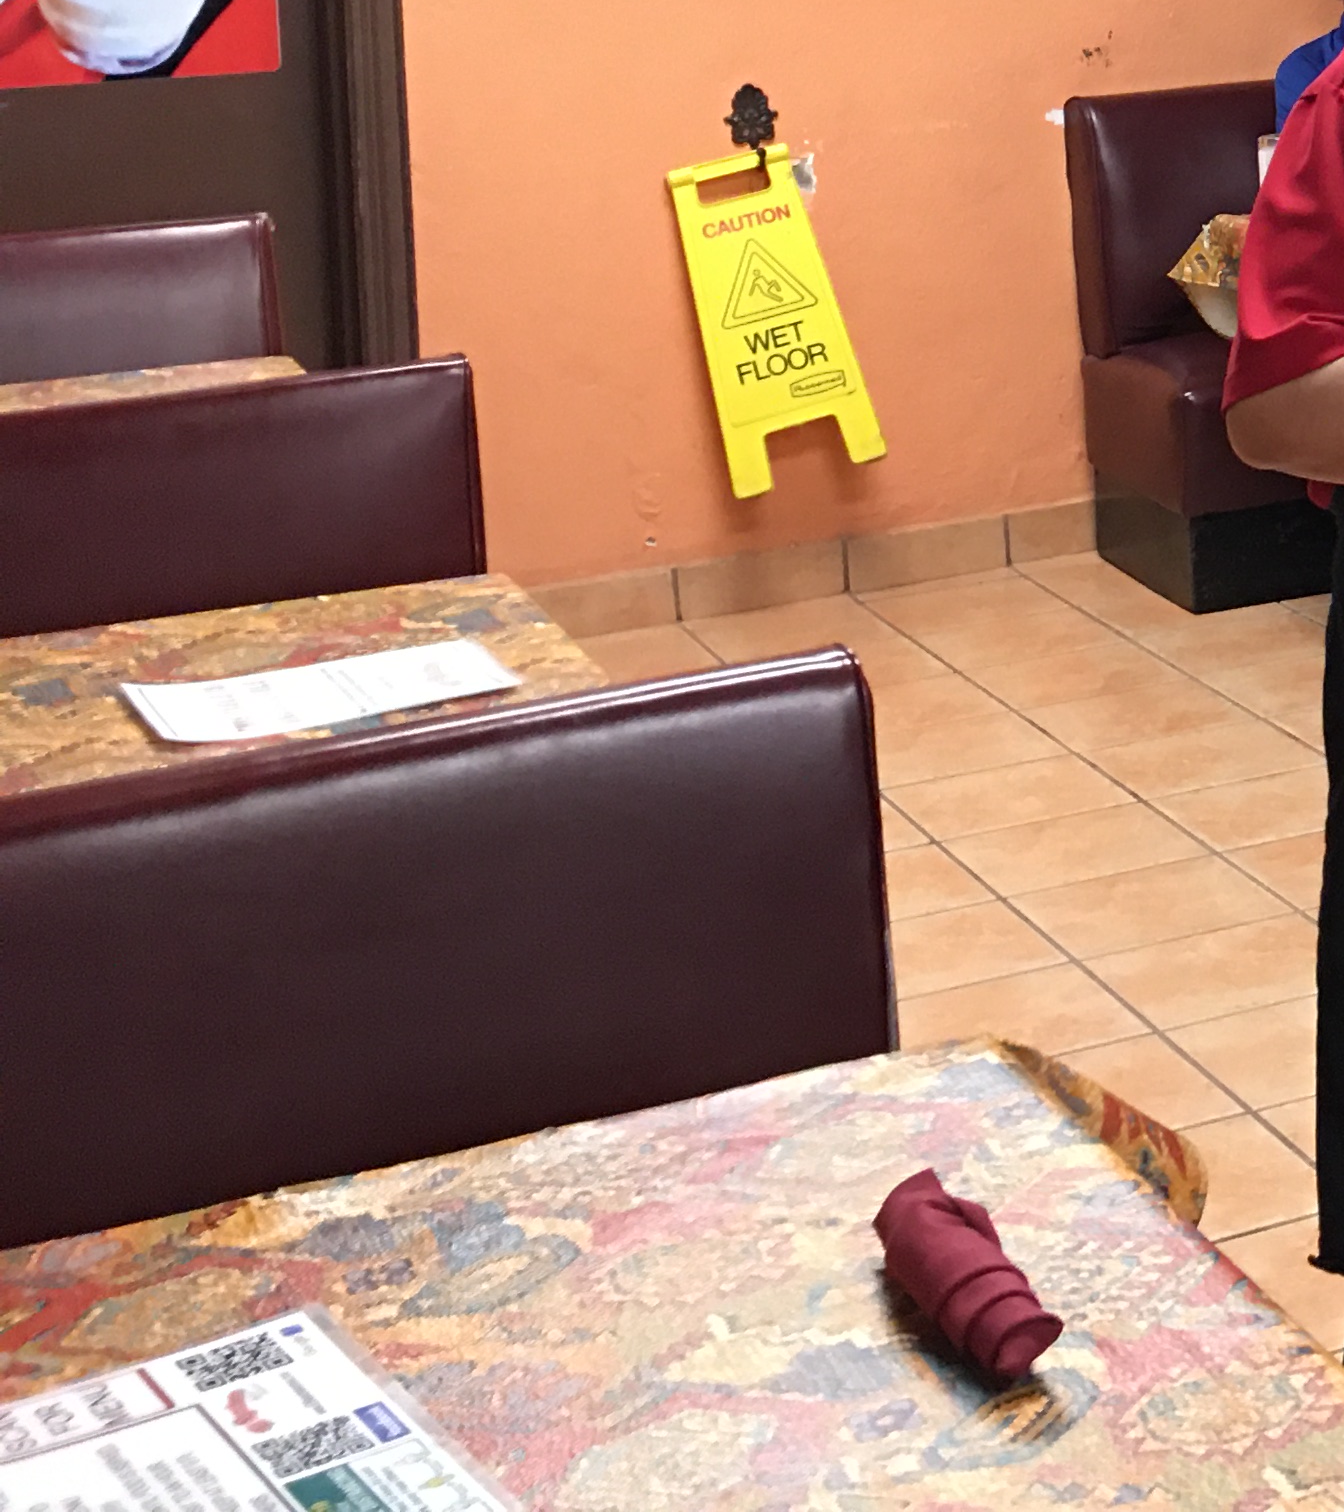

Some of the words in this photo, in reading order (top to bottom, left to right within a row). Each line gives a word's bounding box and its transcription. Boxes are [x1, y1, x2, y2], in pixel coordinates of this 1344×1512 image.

[702, 204, 791, 238] CAUTION
[744, 320, 804, 355] WET
[736, 342, 828, 385] FLOOR
